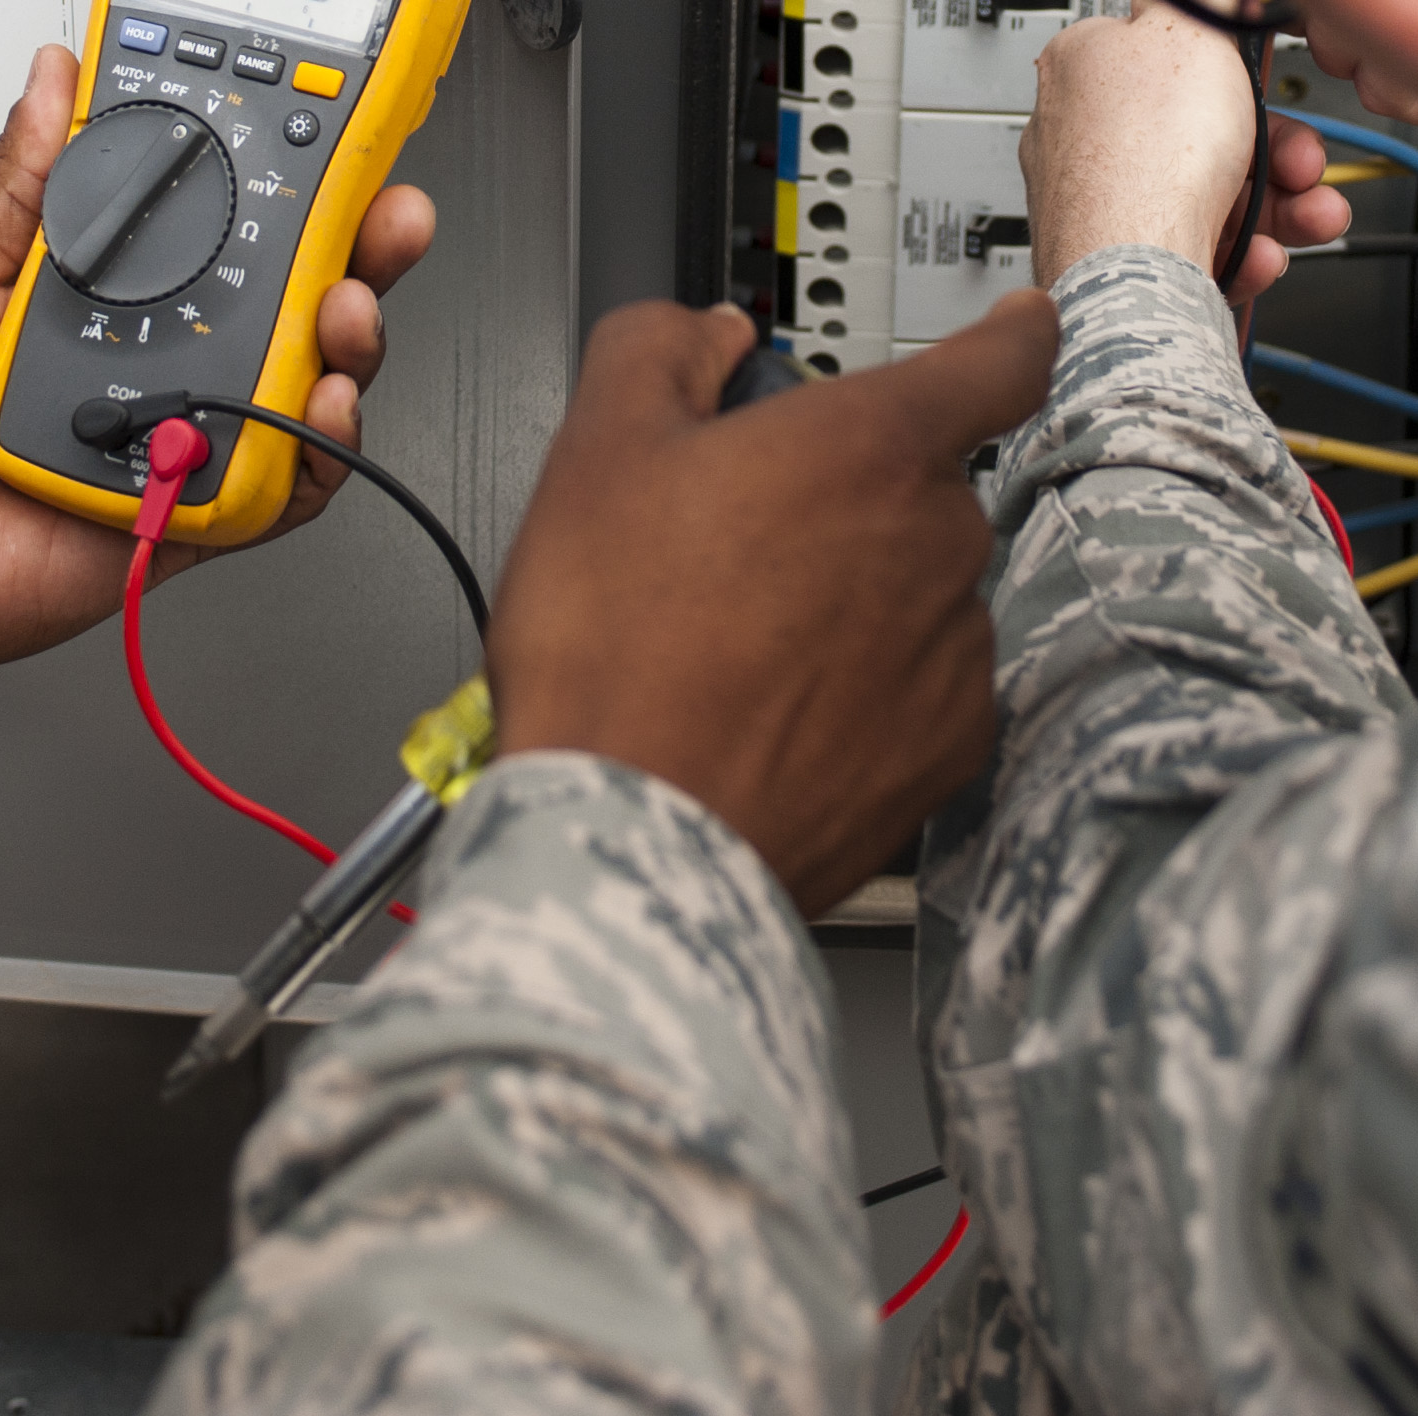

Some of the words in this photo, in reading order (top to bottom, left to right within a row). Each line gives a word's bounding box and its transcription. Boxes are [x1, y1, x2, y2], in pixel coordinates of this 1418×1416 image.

[125, 27, 155, 41] HOLD
[178, 39, 196, 53] MIN
[196, 44, 217, 58] MAX
[112, 64, 155, 82] AUTO-V
[237, 54, 275, 73] RANGE
[118, 79, 141, 93] LoZ
[160, 81, 189, 97] OFF
[206, 98, 220, 114] V
[227, 93, 243, 106] Hz
[247, 178, 279, 197] mV
[239, 220, 259, 242] Ω
